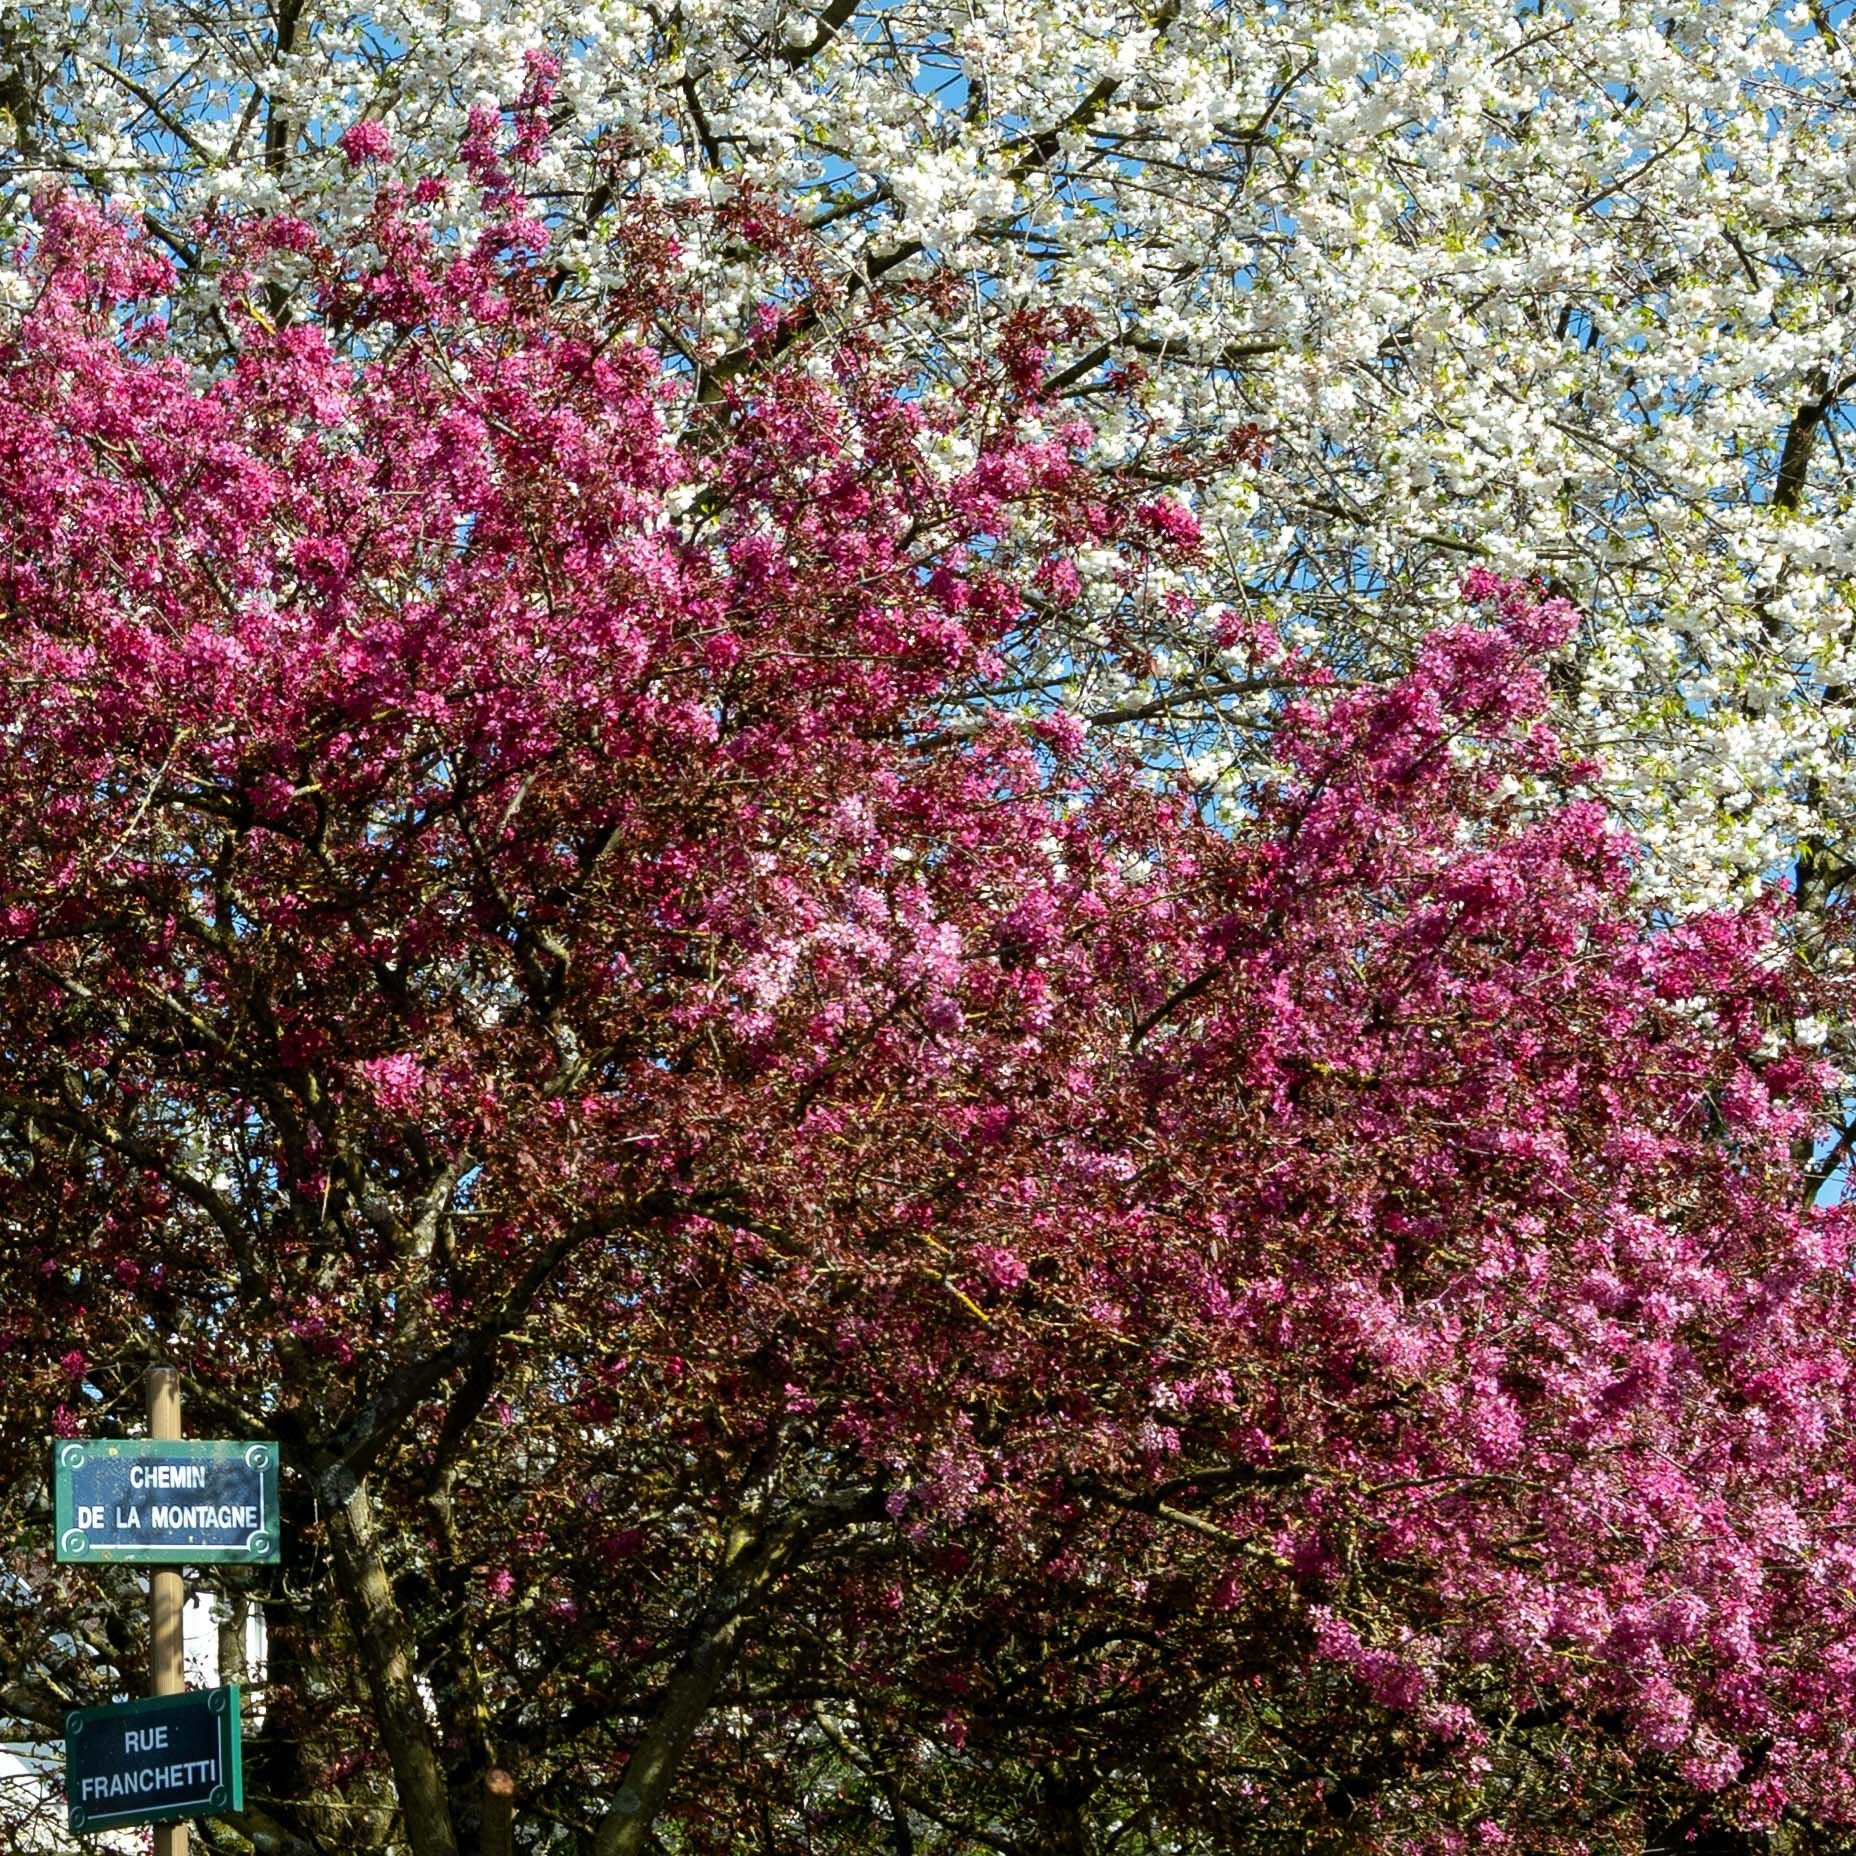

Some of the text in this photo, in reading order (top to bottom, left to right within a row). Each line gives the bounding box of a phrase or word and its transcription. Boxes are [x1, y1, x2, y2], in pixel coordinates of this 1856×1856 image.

[130, 1466, 205, 1488] CHEMIN
[78, 1506, 257, 1528] DE LA MONTAGNE
[125, 1726, 168, 1754] RUE
[82, 1759, 216, 1801] FRANCHETTI
